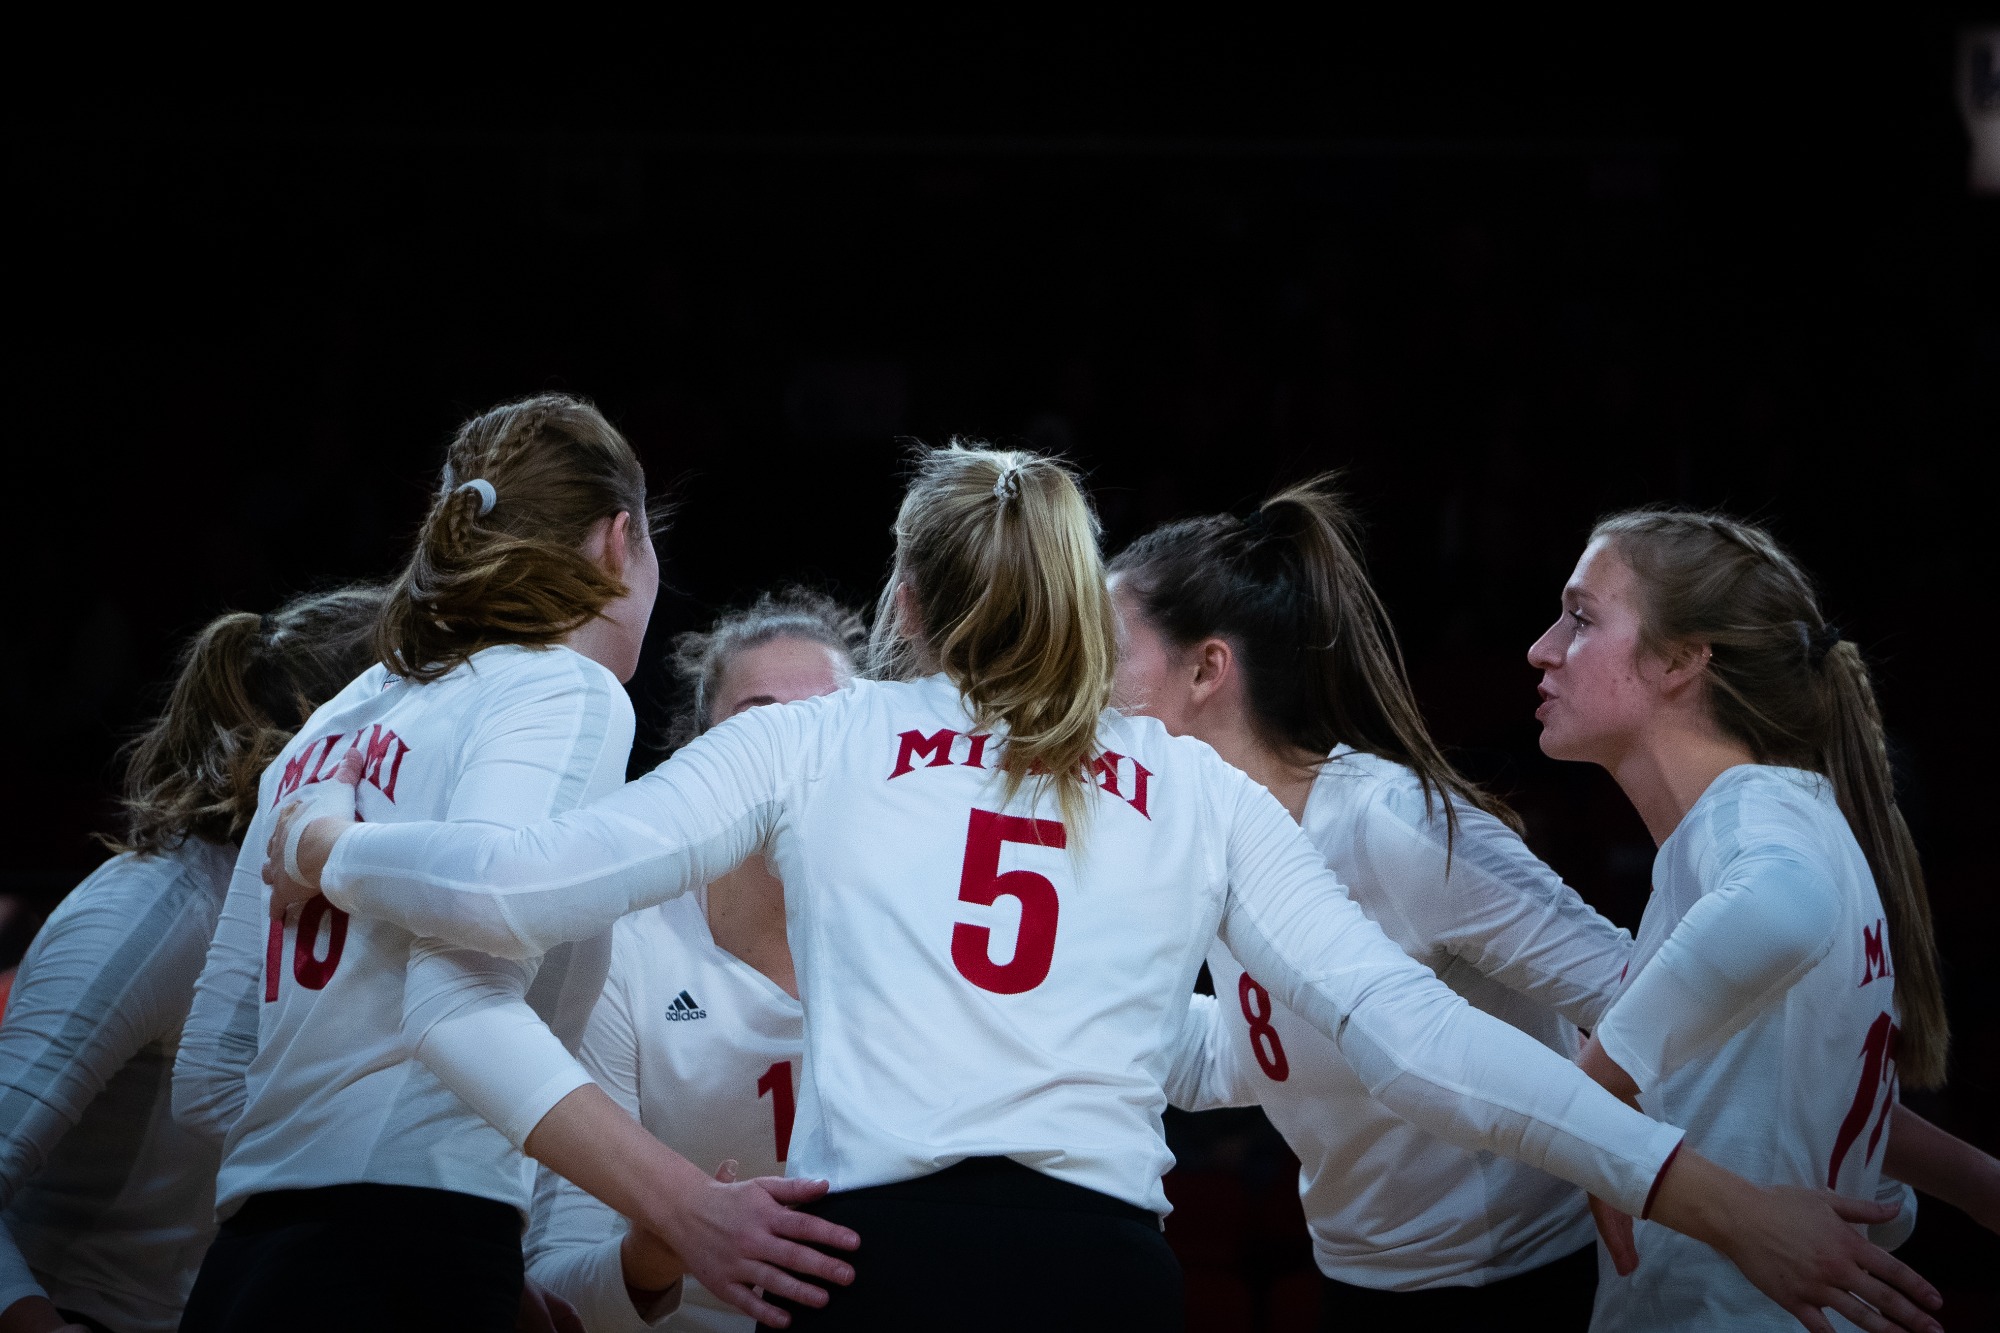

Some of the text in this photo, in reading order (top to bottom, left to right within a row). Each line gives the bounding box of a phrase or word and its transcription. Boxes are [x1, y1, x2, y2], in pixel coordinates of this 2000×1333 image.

[887, 728, 1154, 821] MIMI
[951, 807, 1067, 995] 5
[665, 1009, 707, 1022] adidas
[1238, 970, 1290, 1083] 8
